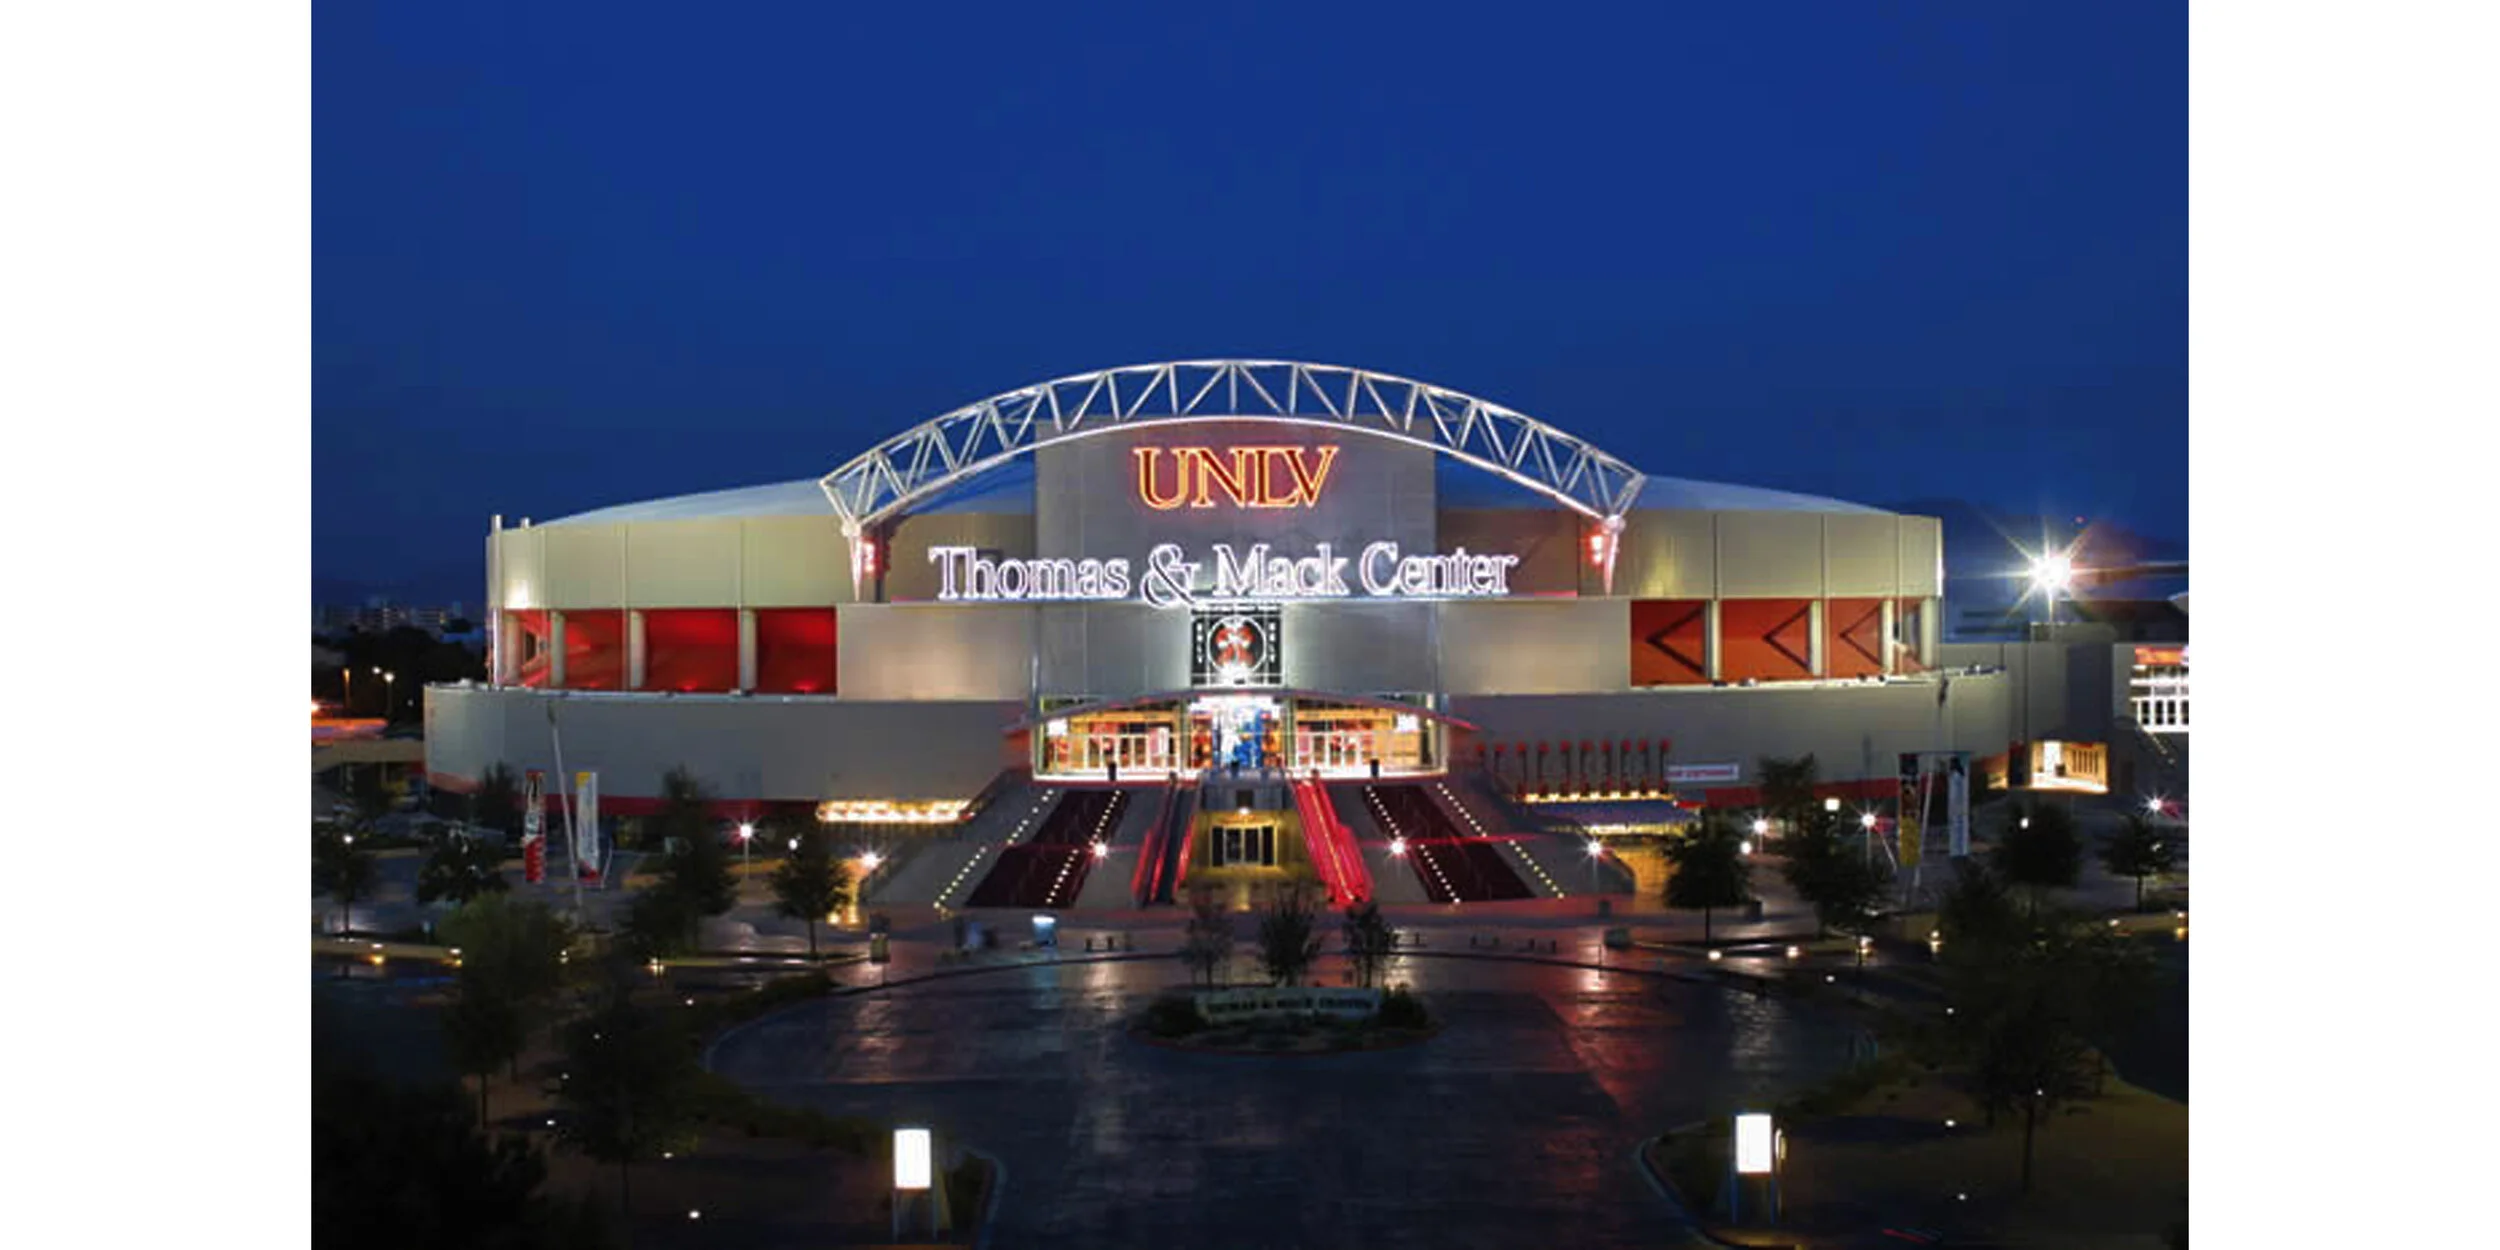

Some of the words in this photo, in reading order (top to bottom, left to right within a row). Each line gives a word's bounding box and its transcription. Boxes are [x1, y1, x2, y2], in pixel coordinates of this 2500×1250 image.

[1133, 446, 1340, 509] UNLV
[928, 545, 1130, 600] Thomas
[1140, 543, 1201, 607] &
[1212, 543, 1349, 597] Mack
[1359, 541, 1519, 596] Center
